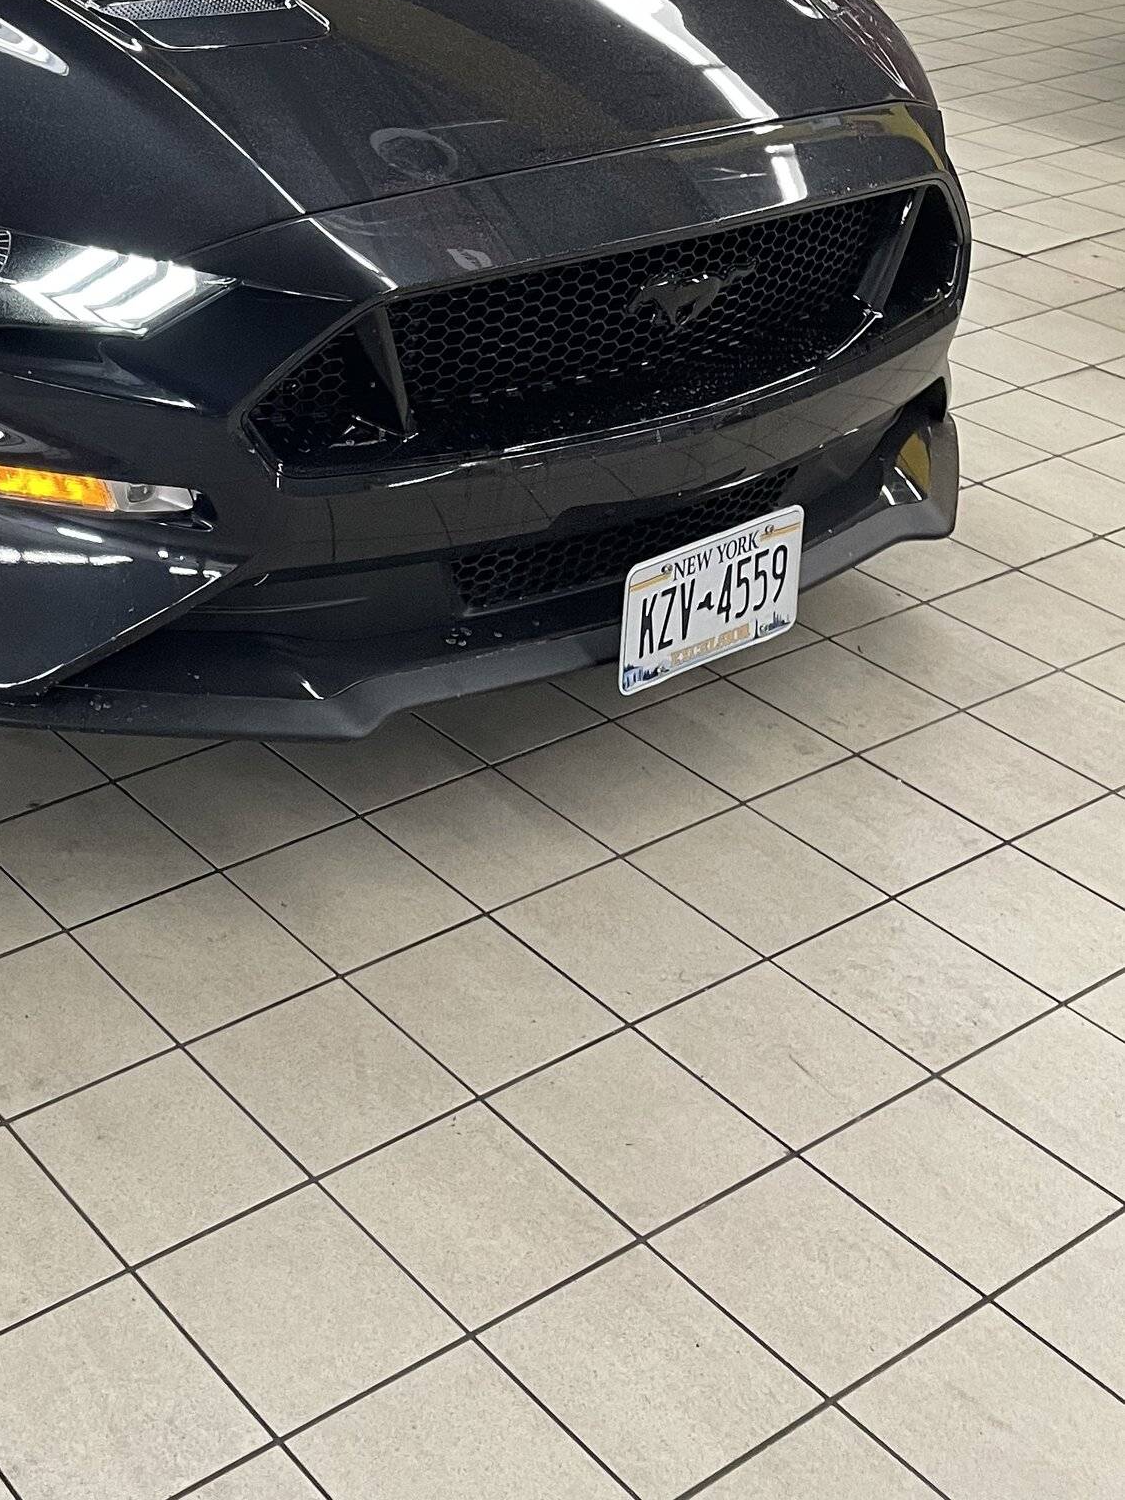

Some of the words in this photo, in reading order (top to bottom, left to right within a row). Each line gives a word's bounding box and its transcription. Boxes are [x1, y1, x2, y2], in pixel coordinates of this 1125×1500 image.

[672, 550, 714, 582] NEW
[717, 532, 759, 564] YORK
[638, 578, 696, 659] KZV
[716, 544, 788, 624] 4559
